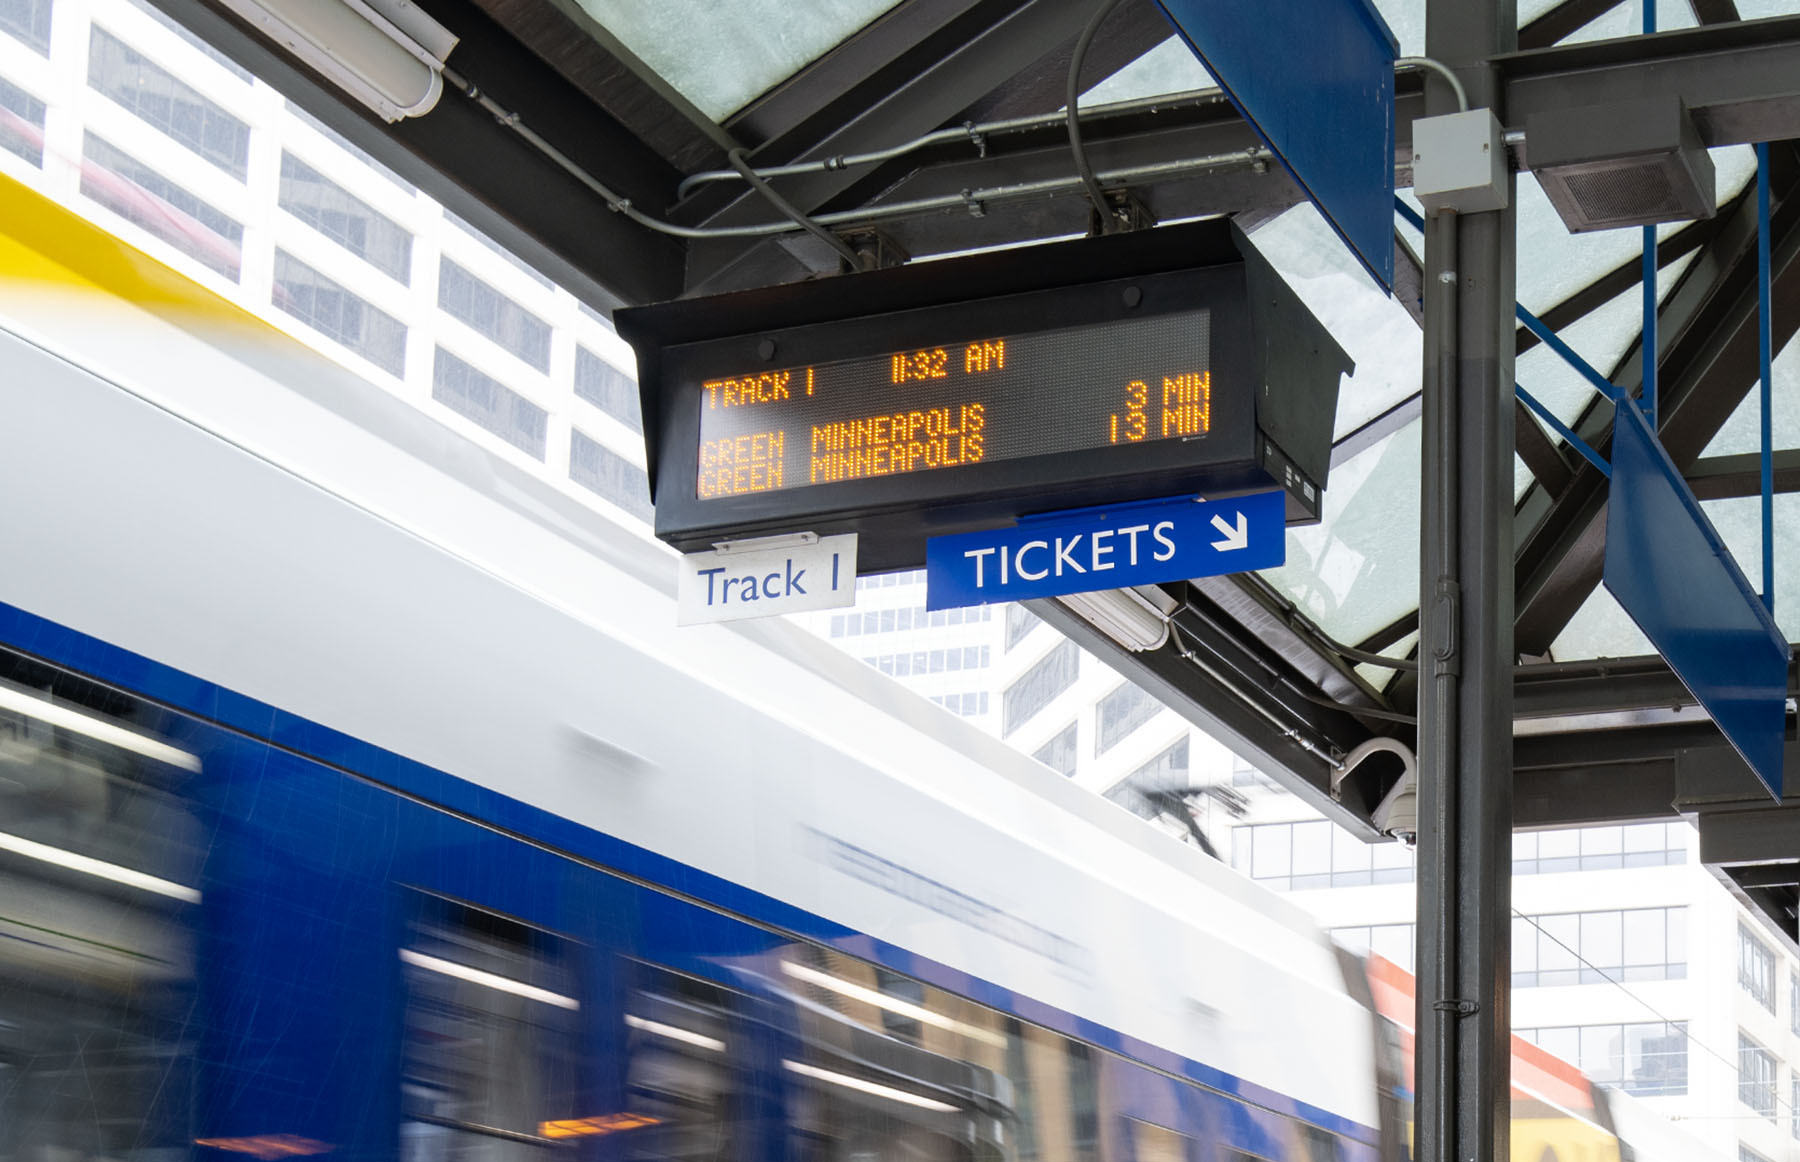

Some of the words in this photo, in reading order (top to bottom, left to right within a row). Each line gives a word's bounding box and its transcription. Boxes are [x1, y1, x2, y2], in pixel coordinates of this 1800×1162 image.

[703, 370, 789, 410] TRACK
[806, 368, 814, 396] 1
[892, 348, 948, 384] 11:32
[965, 340, 1005, 374] AM
[699, 460, 783, 498] GREEN
[810, 433, 984, 483] MINNEAPOLIS
[1110, 411, 1147, 444] 13
[1162, 401, 1210, 437] MIN
[701, 430, 785, 468] GREEN
[811, 402, 985, 454] MINNEAPOLIS
[1126, 380, 1147, 410] 3
[1162, 370, 1210, 406] MIN
[698, 560, 807, 607] Track
[831, 553, 839, 592] 1
[964, 521, 1177, 588] TICKETS
